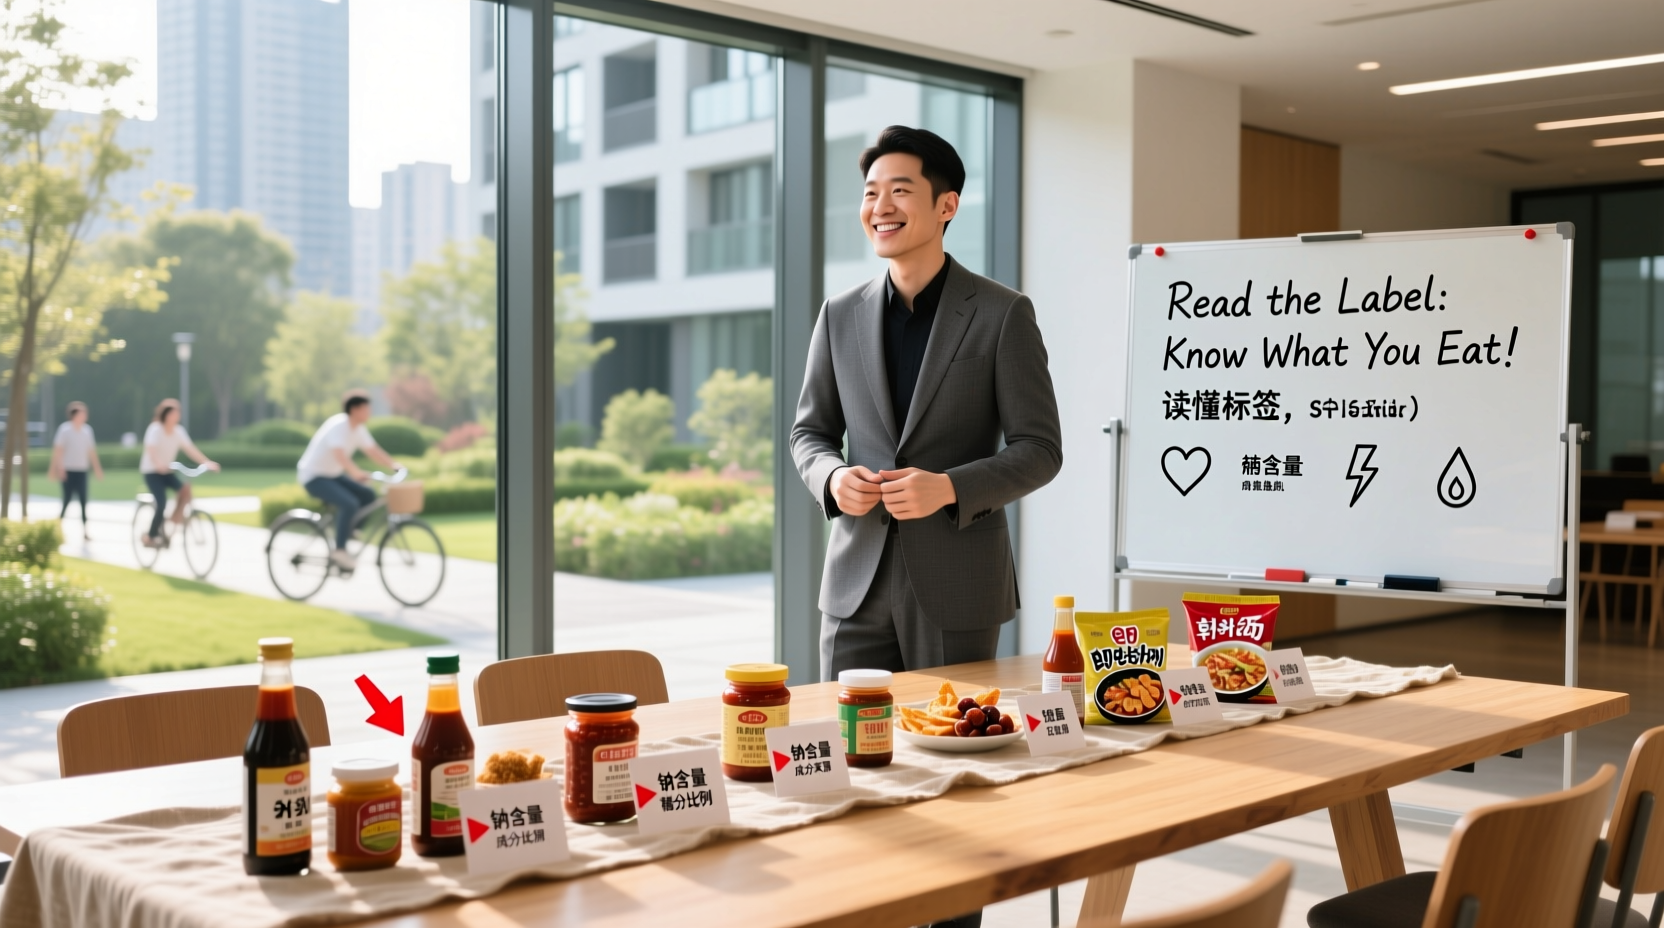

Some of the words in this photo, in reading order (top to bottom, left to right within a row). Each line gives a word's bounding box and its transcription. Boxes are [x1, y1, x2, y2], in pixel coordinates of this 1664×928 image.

[1167, 279, 1253, 321] Read
[1266, 279, 1322, 316] the
[1337, 273, 1447, 315] Label:
[1163, 335, 1248, 371] Know
[1263, 332, 1349, 369] What
[1364, 331, 1421, 370] You
[1437, 325, 1519, 368] Eat!
